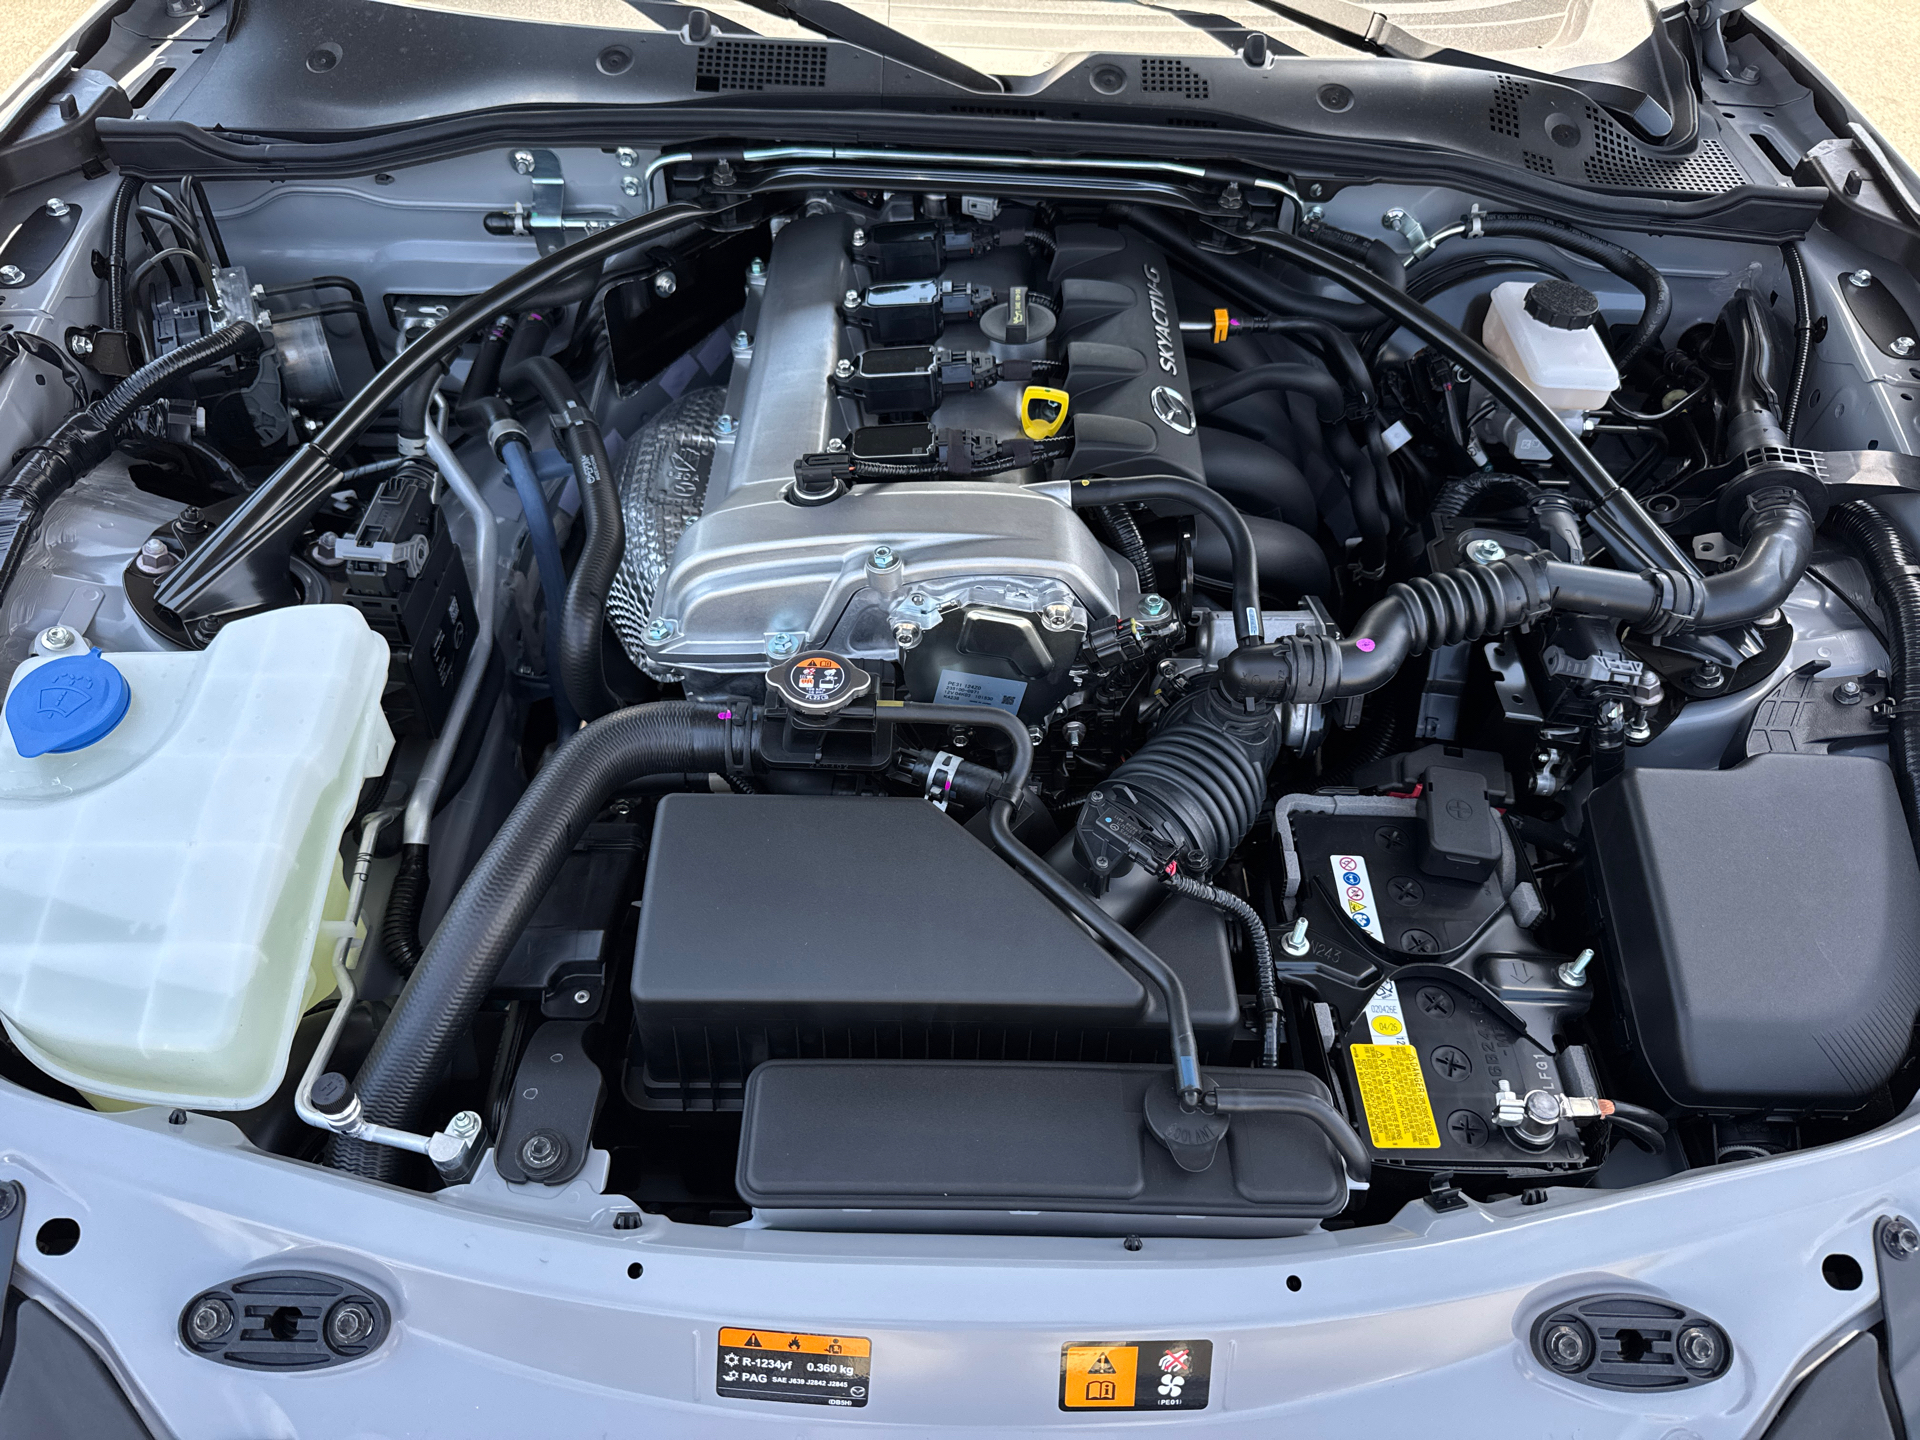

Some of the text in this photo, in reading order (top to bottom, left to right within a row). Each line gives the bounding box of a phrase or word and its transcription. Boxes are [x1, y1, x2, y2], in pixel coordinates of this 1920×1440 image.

[1143, 263, 1178, 376] SKYACTIV-G
[1379, 1022, 1398, 1032] 04/26
[1386, 1058, 1394, 1069] KEEP
[1378, 1059, 1391, 1084] POISON
[1389, 1070, 1397, 1082] VENT
[1533, 1054, 1555, 1090] LFG1
[1384, 1086, 1394, 1102] CAUSES
[1392, 1083, 1400, 1094] CAPS
[1396, 1096, 1404, 1108] TIGHT
[1410, 1062, 1424, 1092] DANGER
[1417, 1094, 1429, 1118] EXPLOSIVE
[1424, 1119, 1434, 1135] GASES
[1367, 1087, 1376, 1102] REACH
[1372, 1110, 1384, 1132] CHILDREN
[1388, 1104, 1398, 1122] SEVERE
[1398, 1110, 1406, 1118] AND
[1393, 1124, 1402, 1139] BURNS
[1401, 1120, 1410, 1134] LEVEL
[742, 1357, 854, 1376] R-1234yf 0.360 kg
[742, 1372, 768, 1384] PAG
